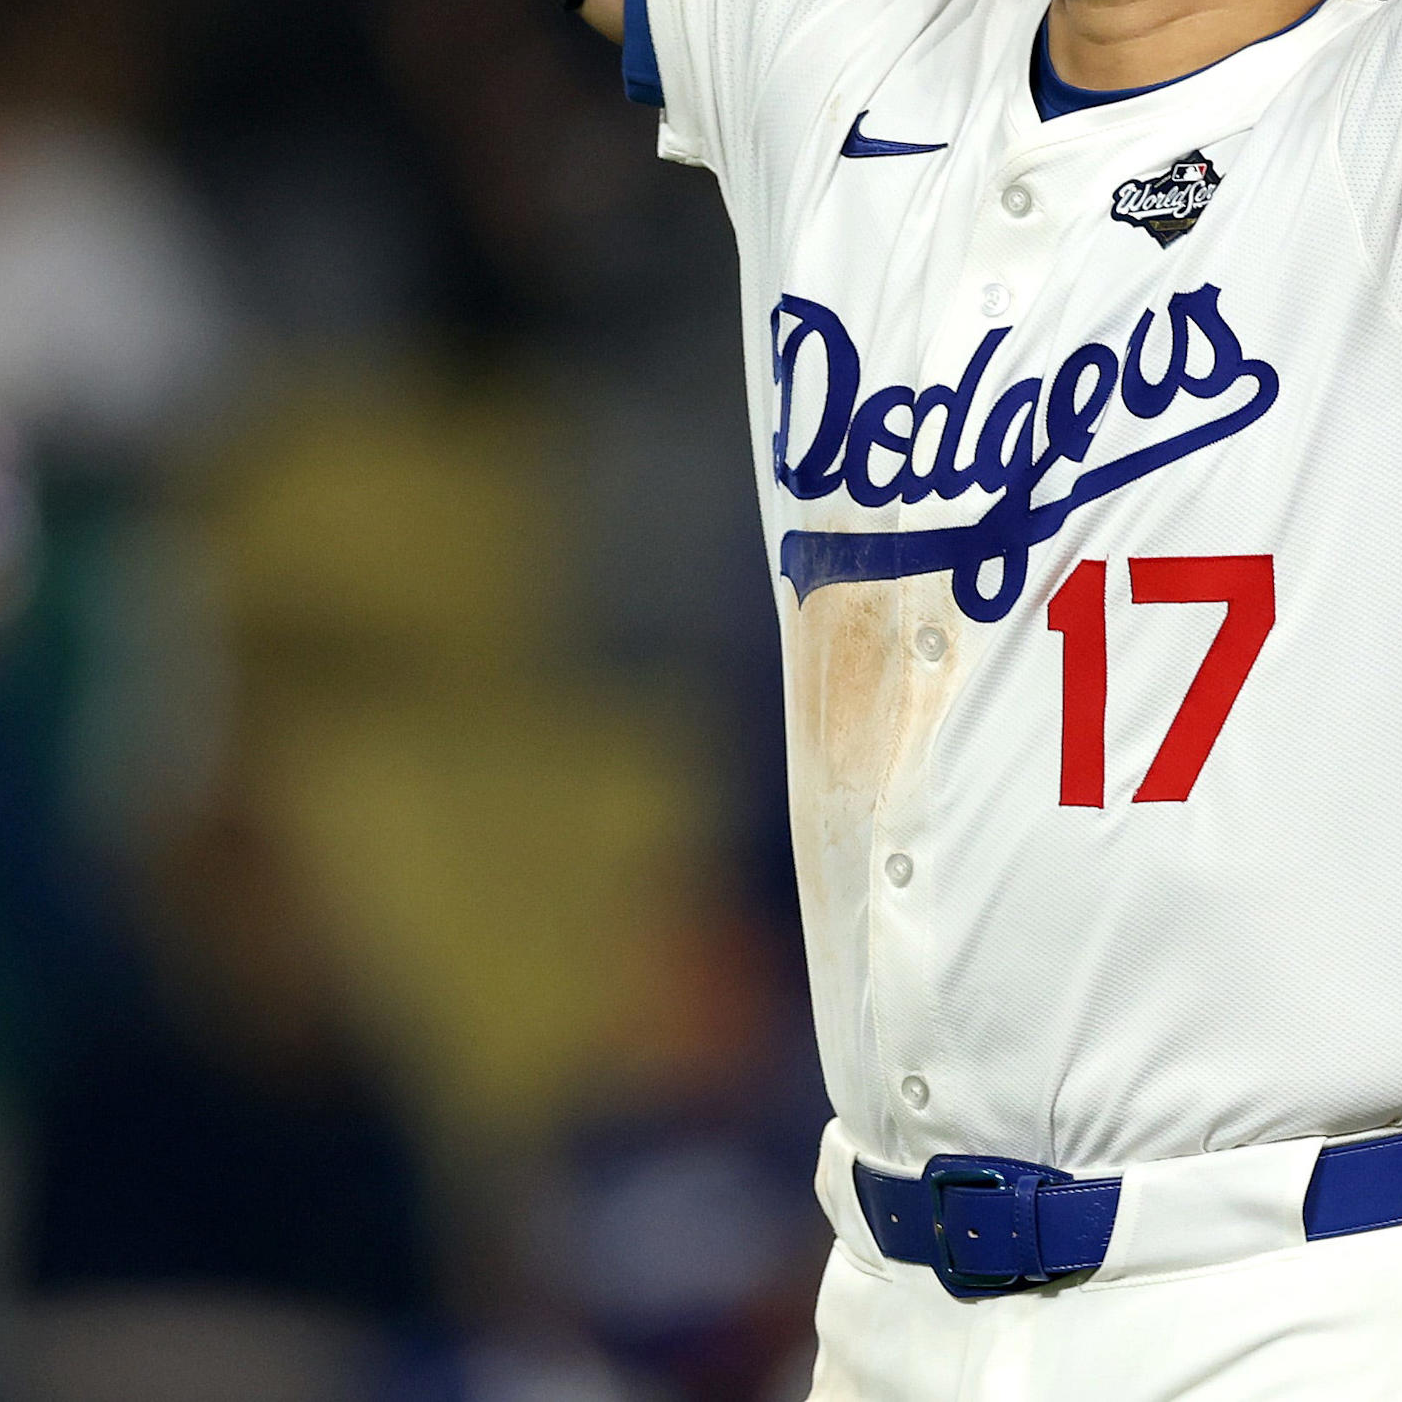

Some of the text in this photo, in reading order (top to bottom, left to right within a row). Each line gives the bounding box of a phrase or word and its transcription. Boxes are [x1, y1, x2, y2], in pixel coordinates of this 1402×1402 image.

[1116, 180, 1216, 219] World Ser
[770, 283, 1279, 623] Dodgers
[1047, 554, 1276, 809] 17
